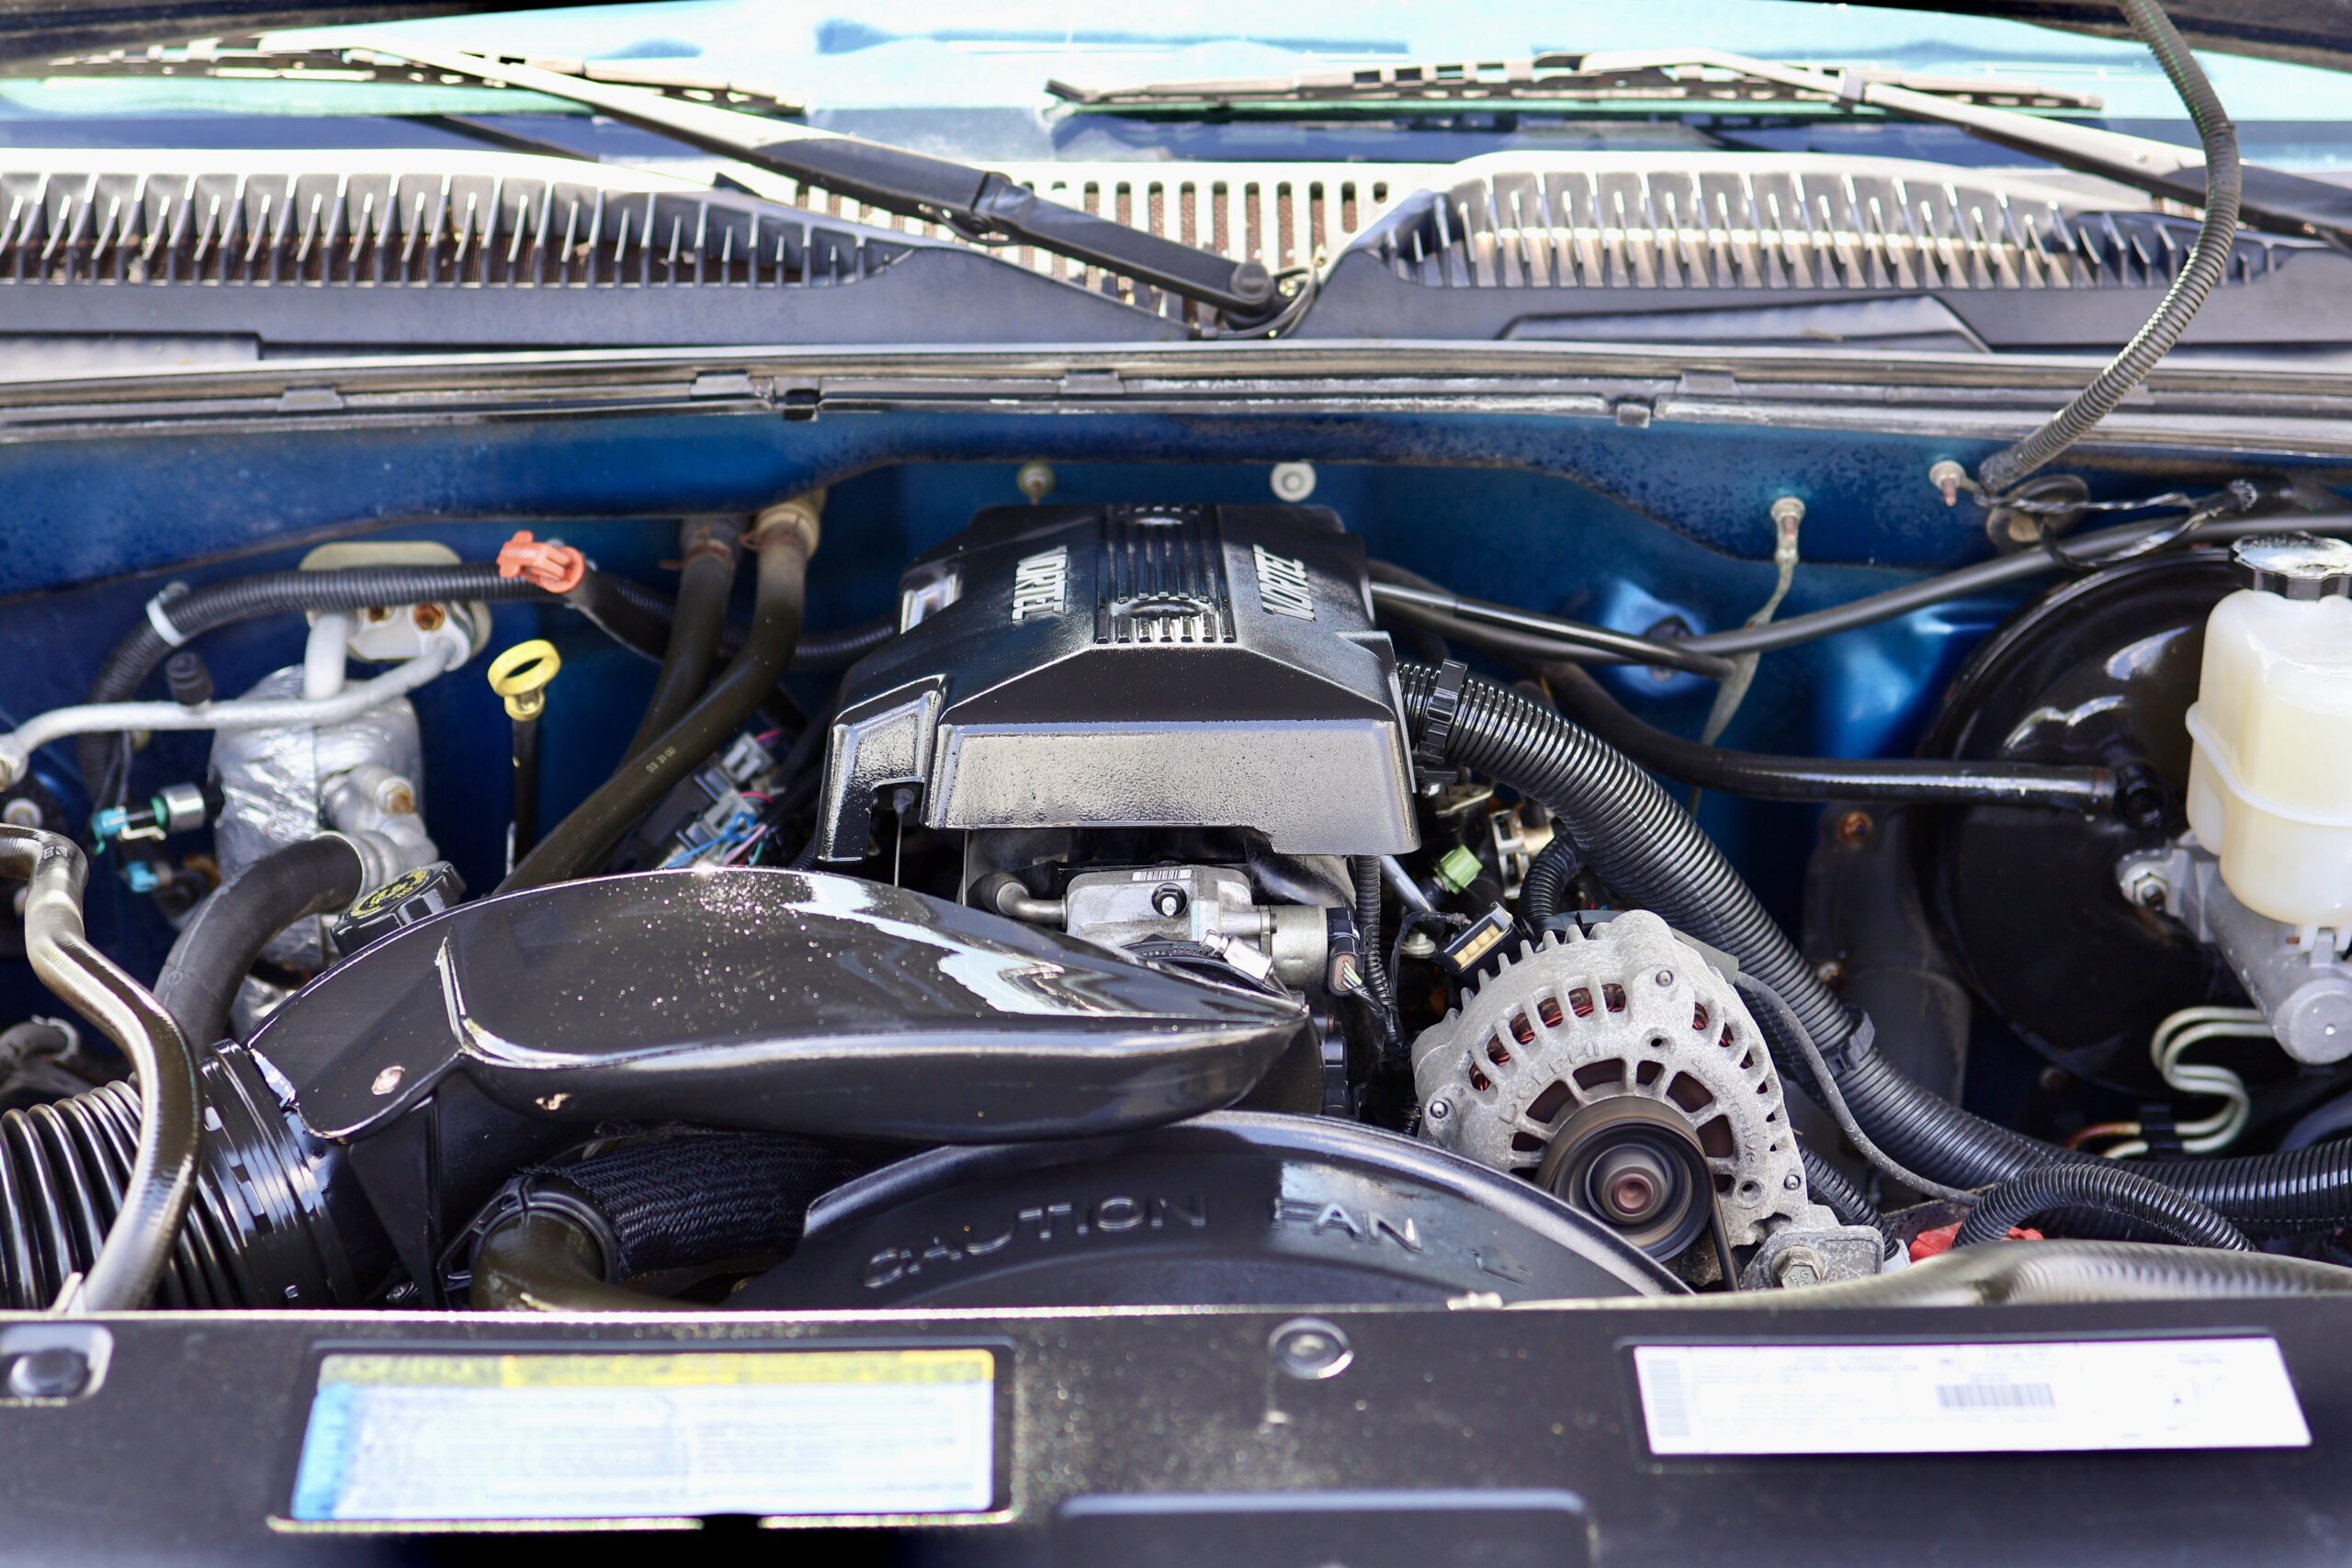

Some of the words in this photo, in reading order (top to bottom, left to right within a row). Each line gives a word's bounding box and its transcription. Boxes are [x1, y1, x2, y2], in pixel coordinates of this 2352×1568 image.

[1012, 545, 1068, 624] VORTEC
[1252, 544, 1316, 622] VORTEC
[1498, 1041, 1600, 1125] DELPHI
[865, 1196, 1206, 1289] CAUTION
[1270, 1197, 1425, 1255] FAN
